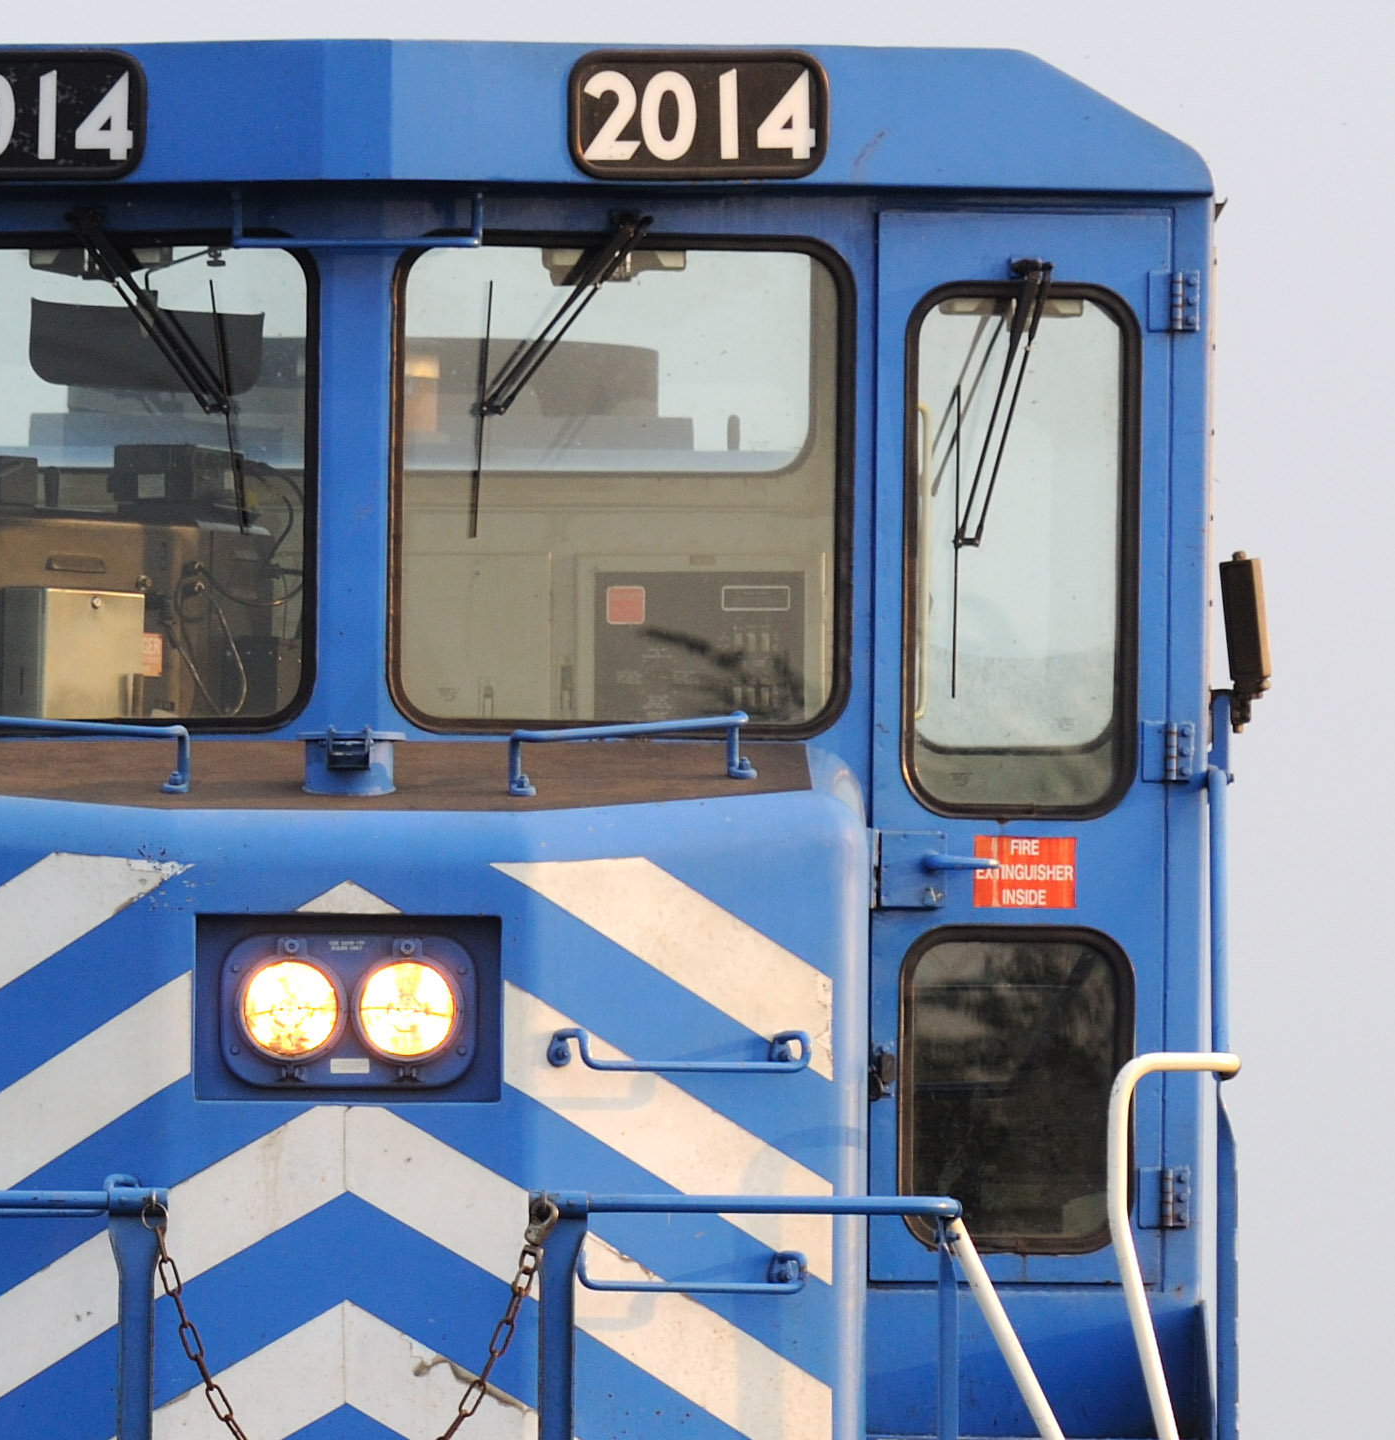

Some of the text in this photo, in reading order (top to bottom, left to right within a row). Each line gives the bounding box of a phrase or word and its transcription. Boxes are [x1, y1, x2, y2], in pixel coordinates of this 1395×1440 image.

[583, 69, 815, 161] 2014
[1010, 840, 1040, 856] FIRE
[1002, 889, 1047, 906] INSIDE
